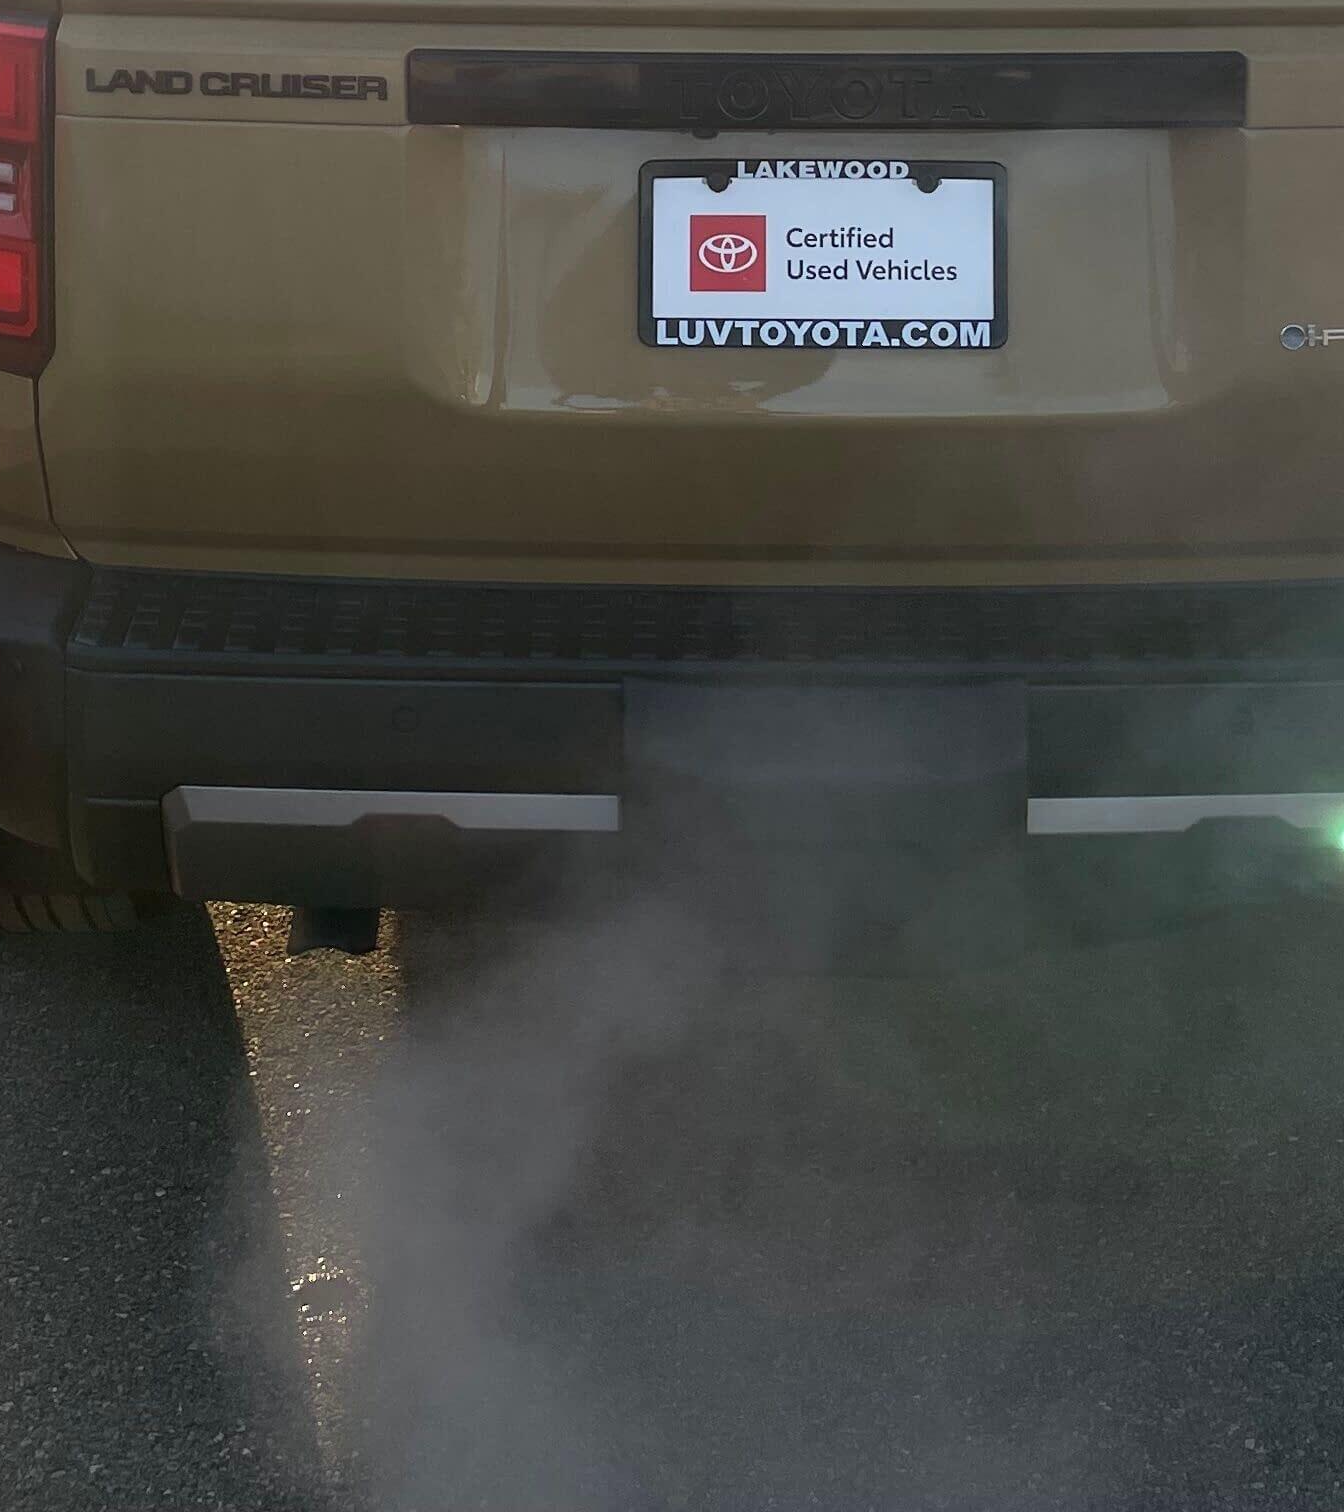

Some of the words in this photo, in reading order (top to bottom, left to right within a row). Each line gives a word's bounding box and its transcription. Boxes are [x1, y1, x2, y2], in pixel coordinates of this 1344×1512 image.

[85, 68, 193, 95] LAND
[199, 71, 389, 101] CRUISER
[663, 68, 990, 121] TOYOTA
[736, 160, 910, 180] LAKEWOOD
[785, 227, 895, 249] Certified
[785, 259, 849, 281] Used
[855, 259, 958, 281] Vehicles
[656, 320, 991, 348] LUVTOYOTA.COM
